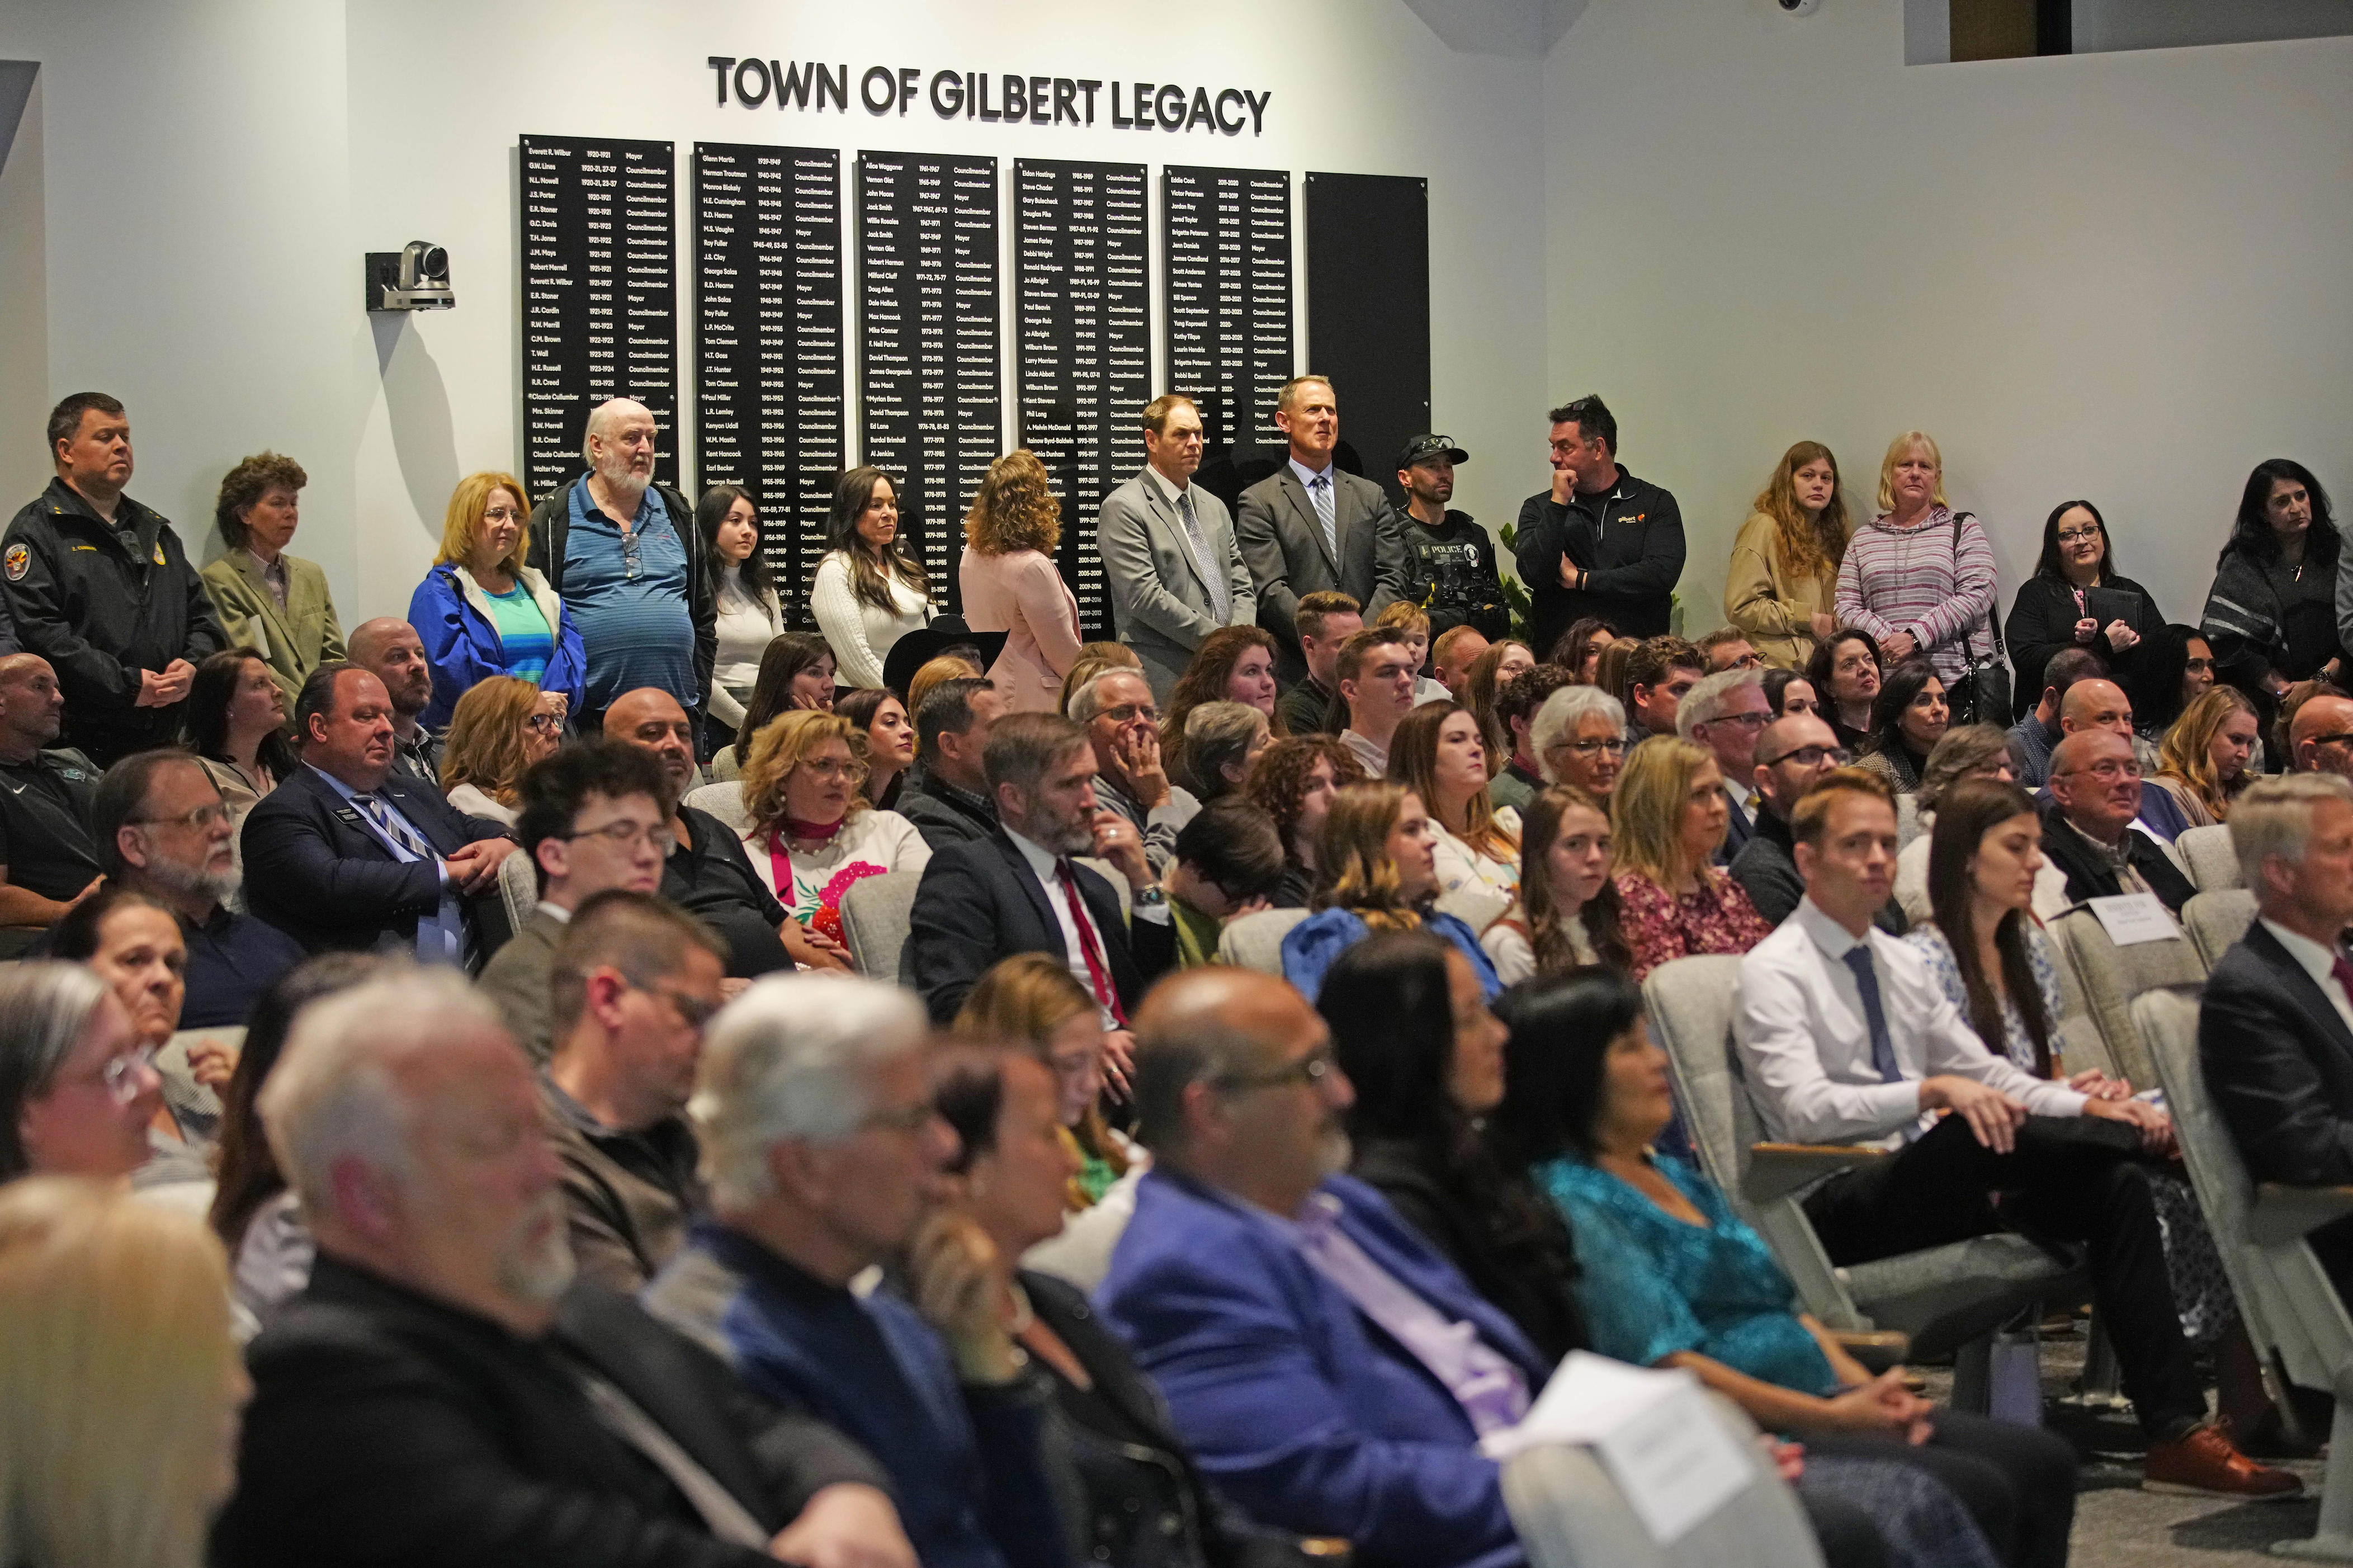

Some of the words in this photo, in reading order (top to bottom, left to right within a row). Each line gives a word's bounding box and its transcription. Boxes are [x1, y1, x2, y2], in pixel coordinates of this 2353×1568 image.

[708, 56, 847, 109] TOWN
[861, 67, 920, 112] OF
[930, 70, 1102, 123] GILBERT
[1112, 82, 1271, 136] LEGACY
[626, 153, 642, 161] Mayor
[626, 167, 667, 175] Councilmember
[1036, 171, 1055, 179] Hastings
[795, 173, 833, 182] Councilmember
[714, 198, 745, 206] Cunningham
[704, 267, 723, 276] George
[1040, 264, 1062, 272] Rodriguez
